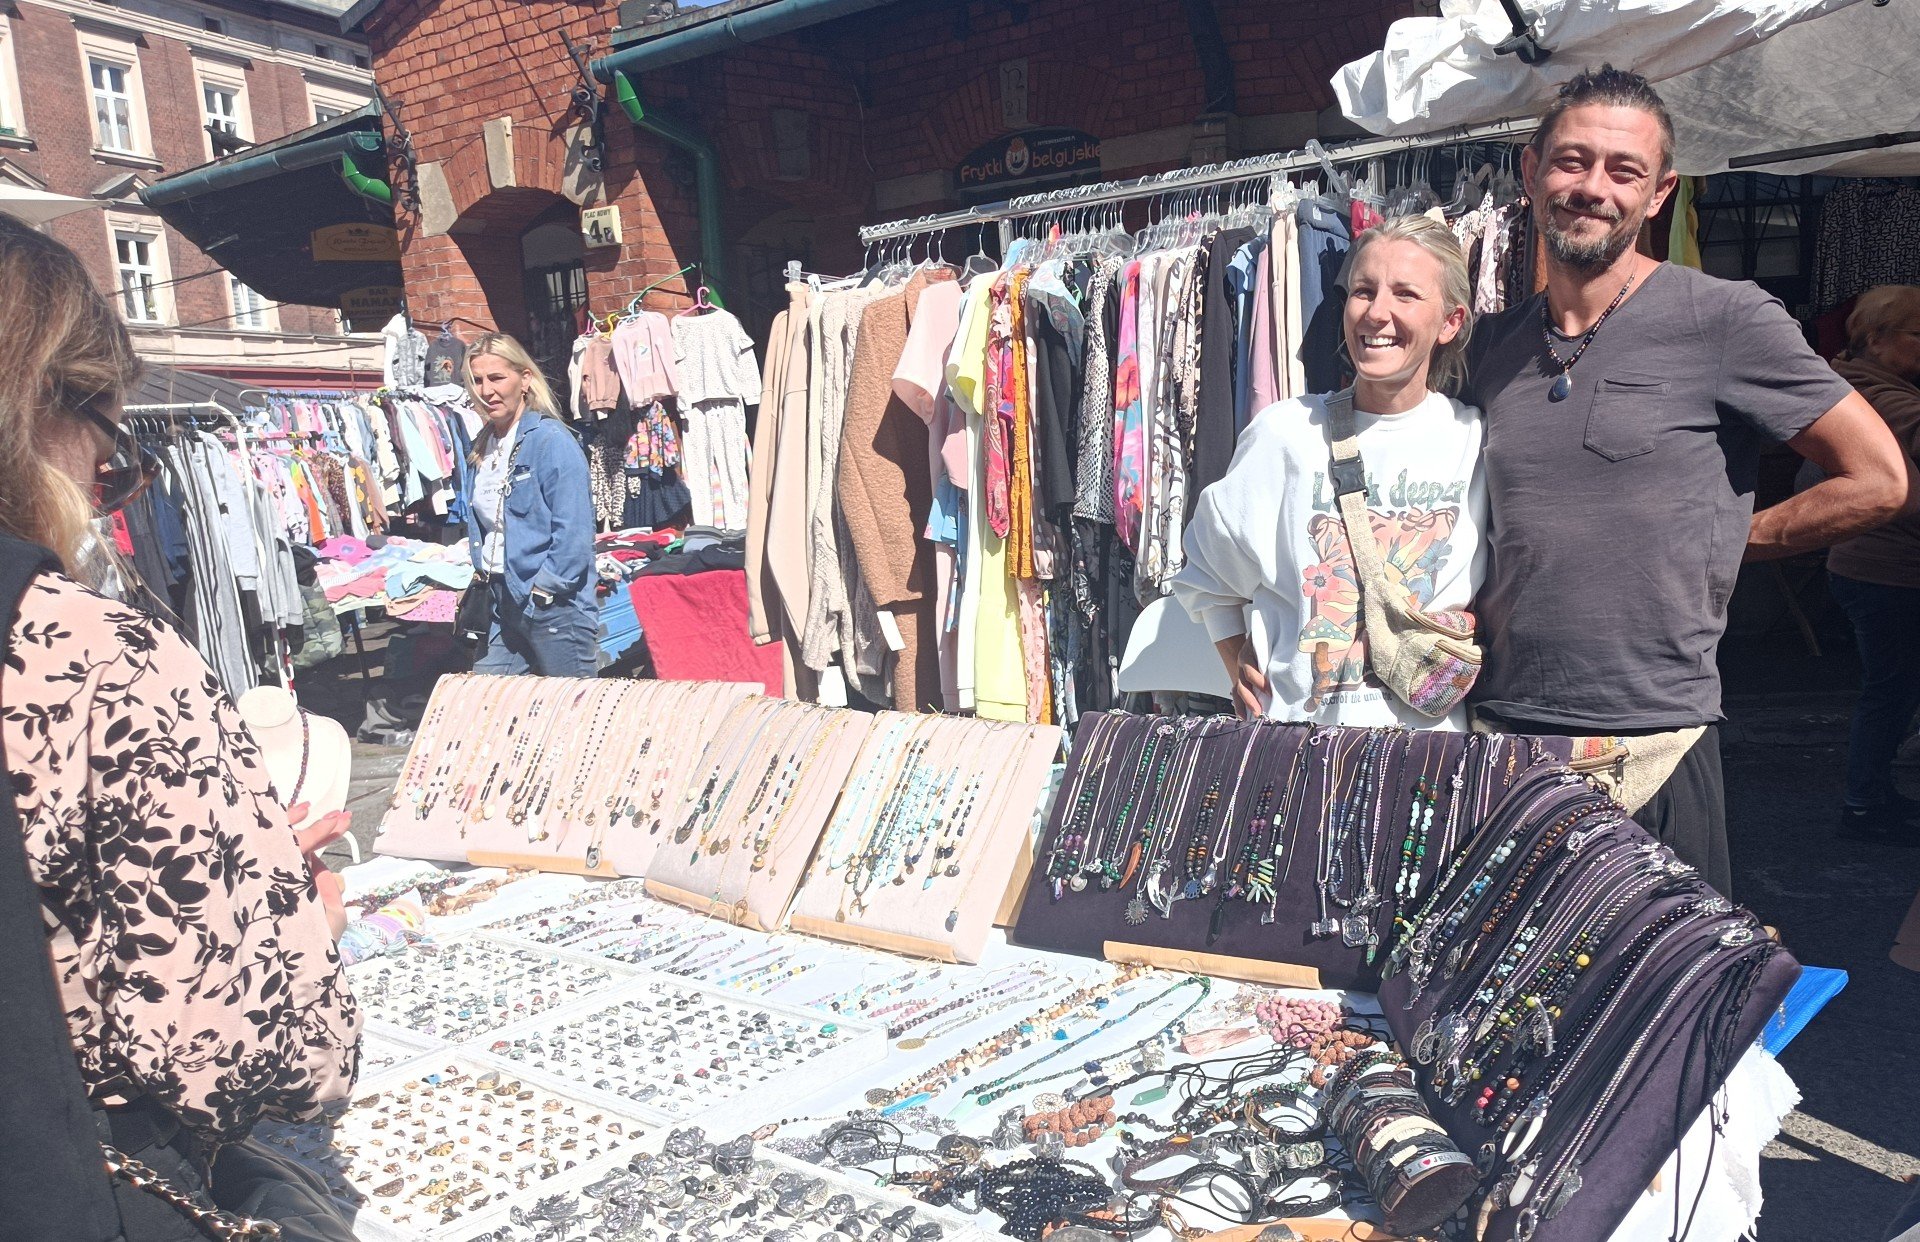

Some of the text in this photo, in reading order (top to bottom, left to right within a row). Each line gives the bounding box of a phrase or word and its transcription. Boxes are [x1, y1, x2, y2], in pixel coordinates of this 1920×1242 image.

[1032, 141, 1102, 168] belgijskie
[584, 209, 610, 219] PLAC NOWY
[1311, 467, 1467, 513] Lk deeper
